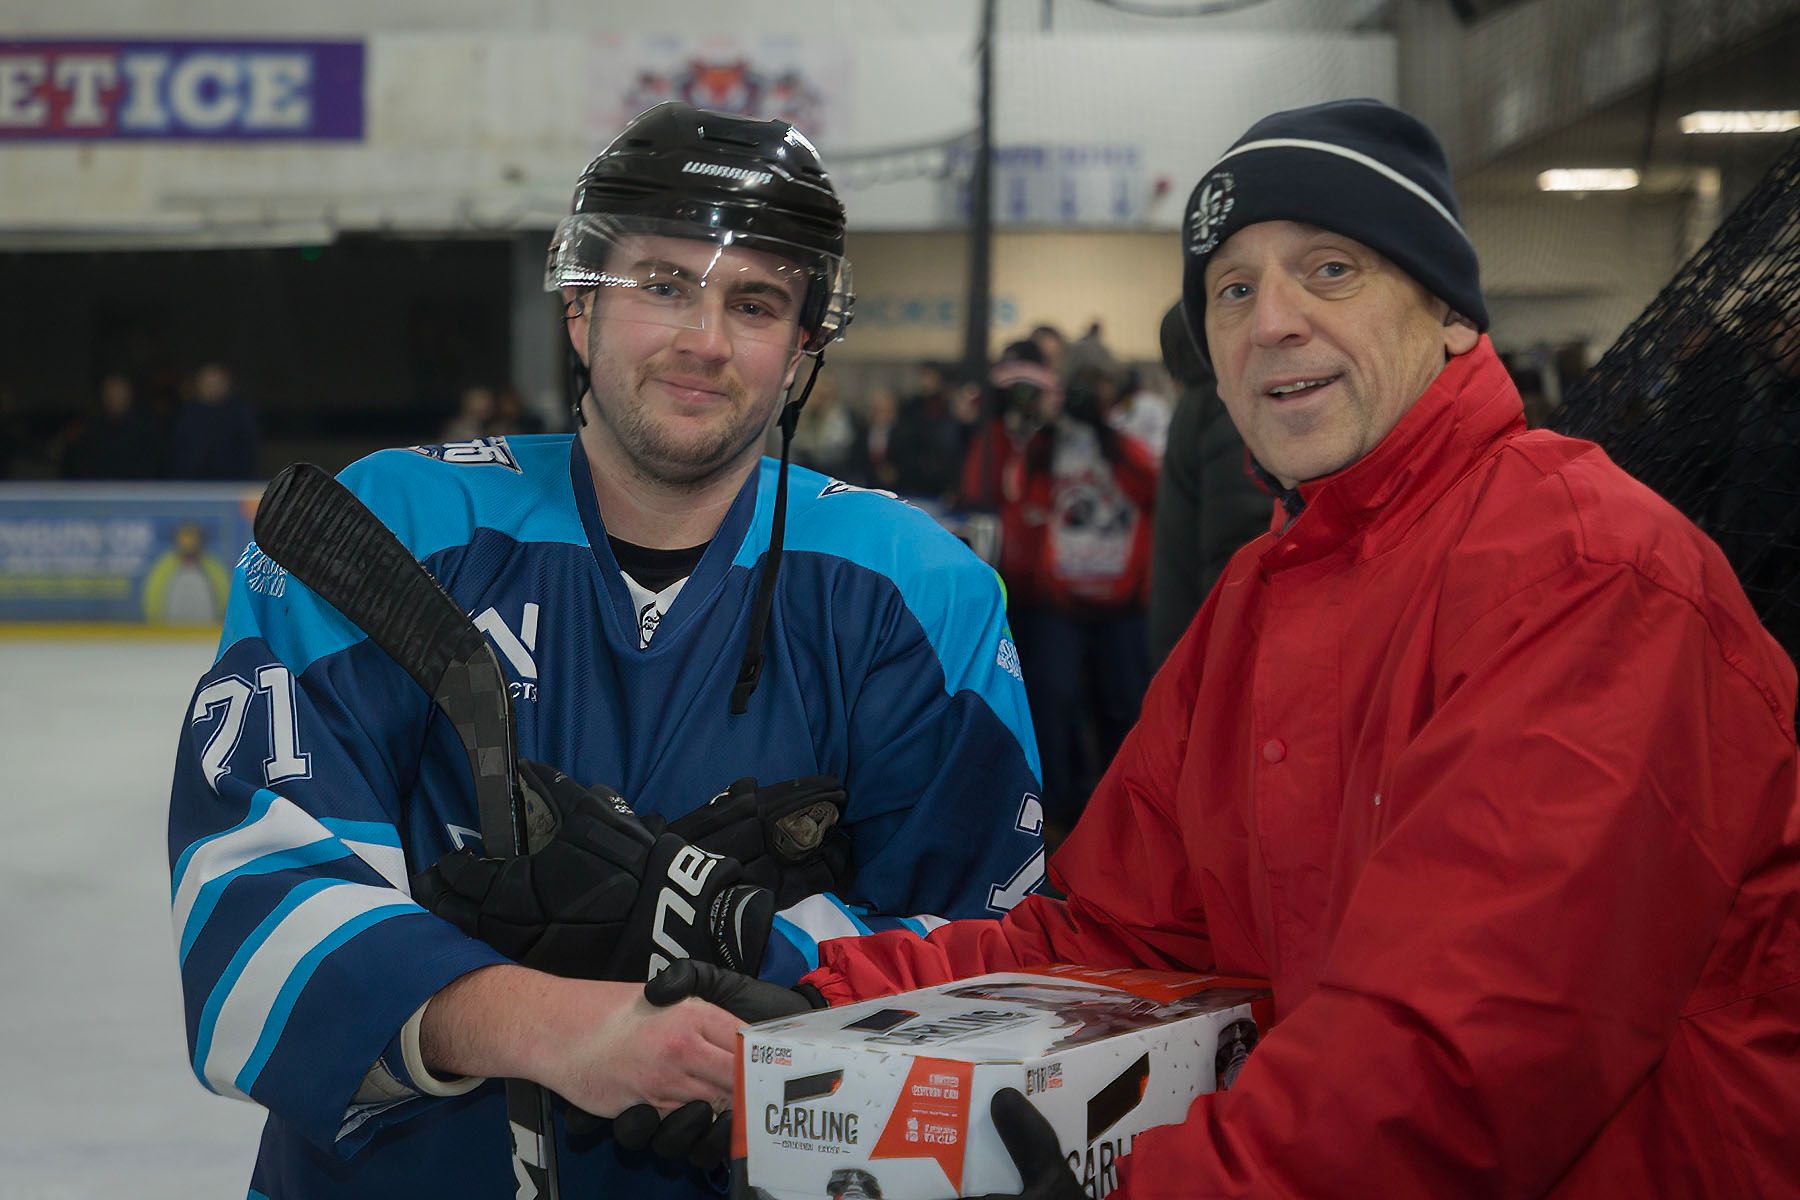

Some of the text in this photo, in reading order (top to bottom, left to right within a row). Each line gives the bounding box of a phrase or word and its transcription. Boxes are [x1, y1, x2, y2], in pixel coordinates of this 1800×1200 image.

[681, 161, 773, 185] WARRIOR
[191, 662, 312, 797] 71
[765, 1103, 859, 1145] CARLING
